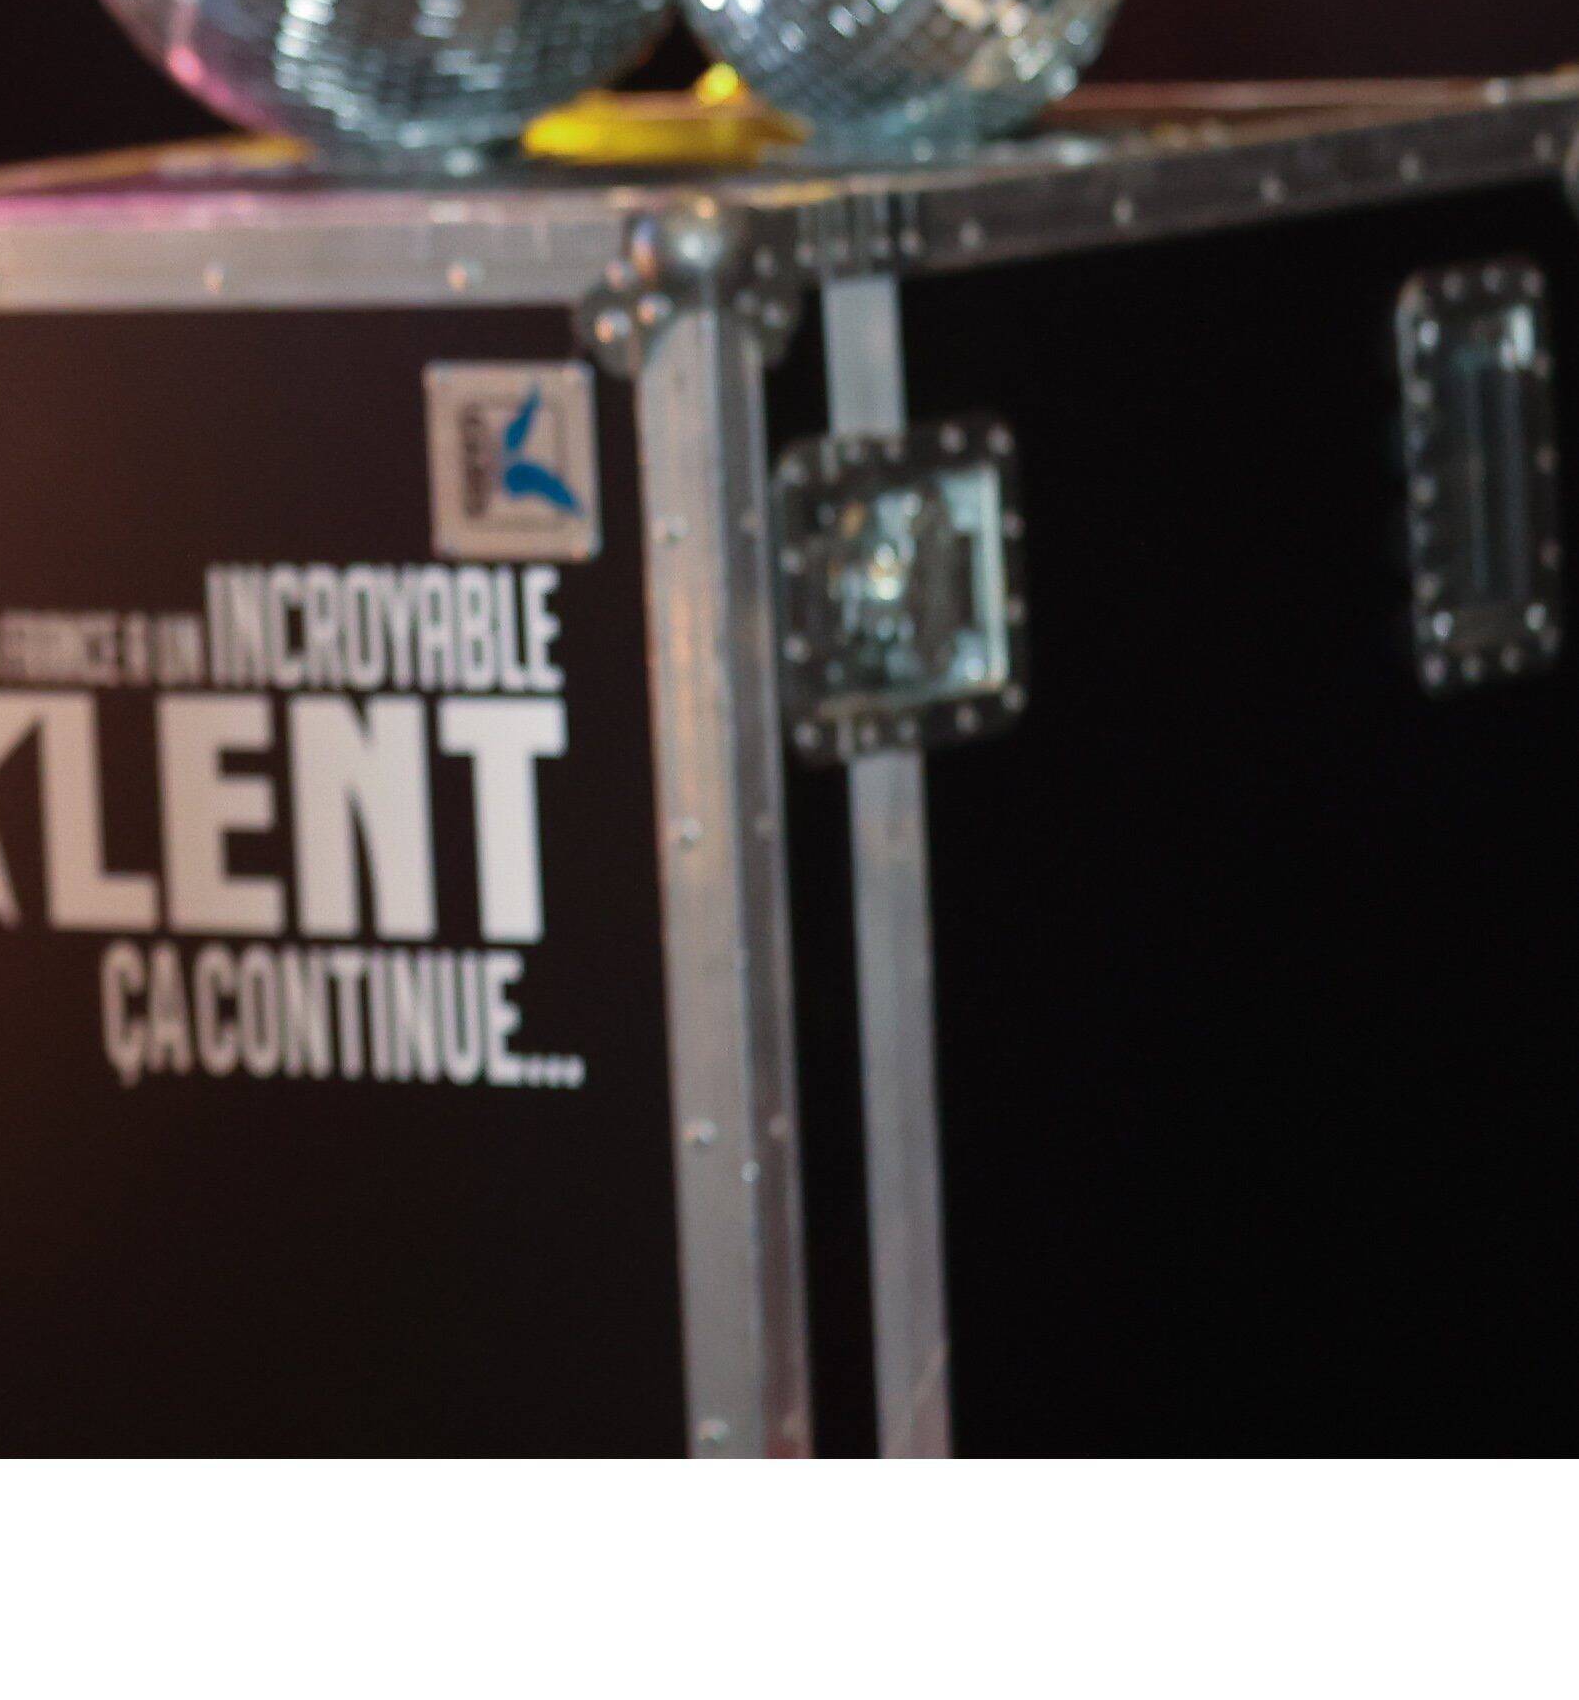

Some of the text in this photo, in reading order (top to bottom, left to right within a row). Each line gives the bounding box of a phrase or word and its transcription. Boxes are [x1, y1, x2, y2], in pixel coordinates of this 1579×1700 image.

[205, 562, 565, 692] INCROYABLE
[101, 942, 587, 1090] ÇA CONTINUE...
